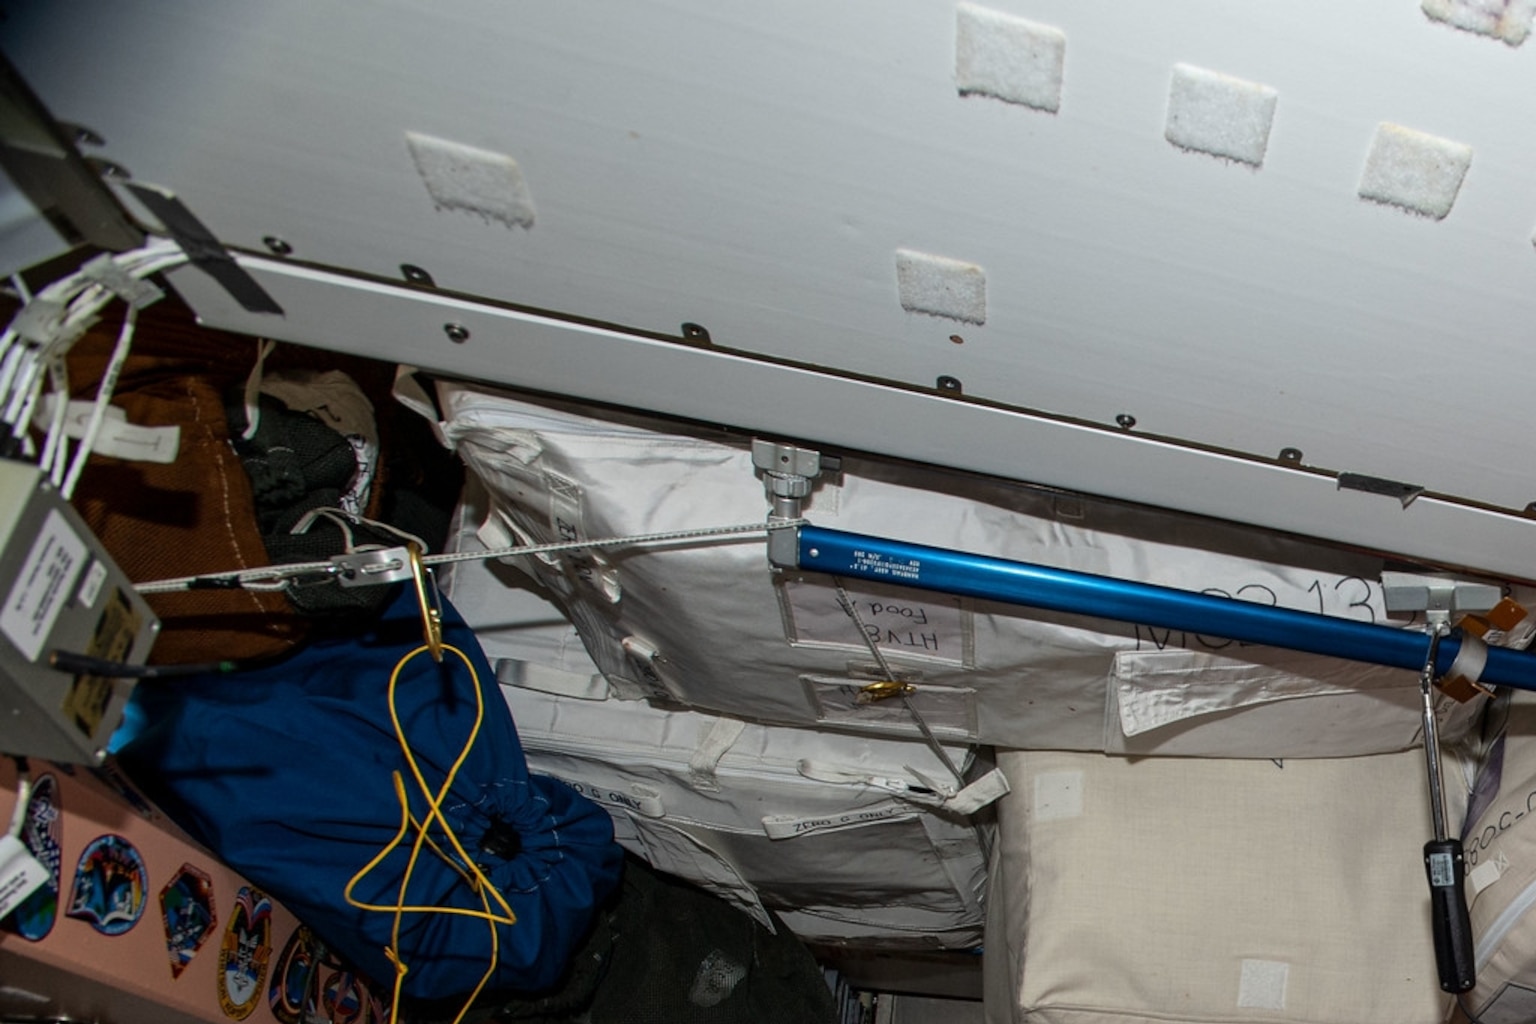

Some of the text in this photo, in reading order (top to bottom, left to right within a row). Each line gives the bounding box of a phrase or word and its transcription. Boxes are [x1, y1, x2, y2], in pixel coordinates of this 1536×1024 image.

[868, 602, 928, 625] Food
[608, 792, 643, 809] ONLY
[792, 818, 832, 833] ZERO
